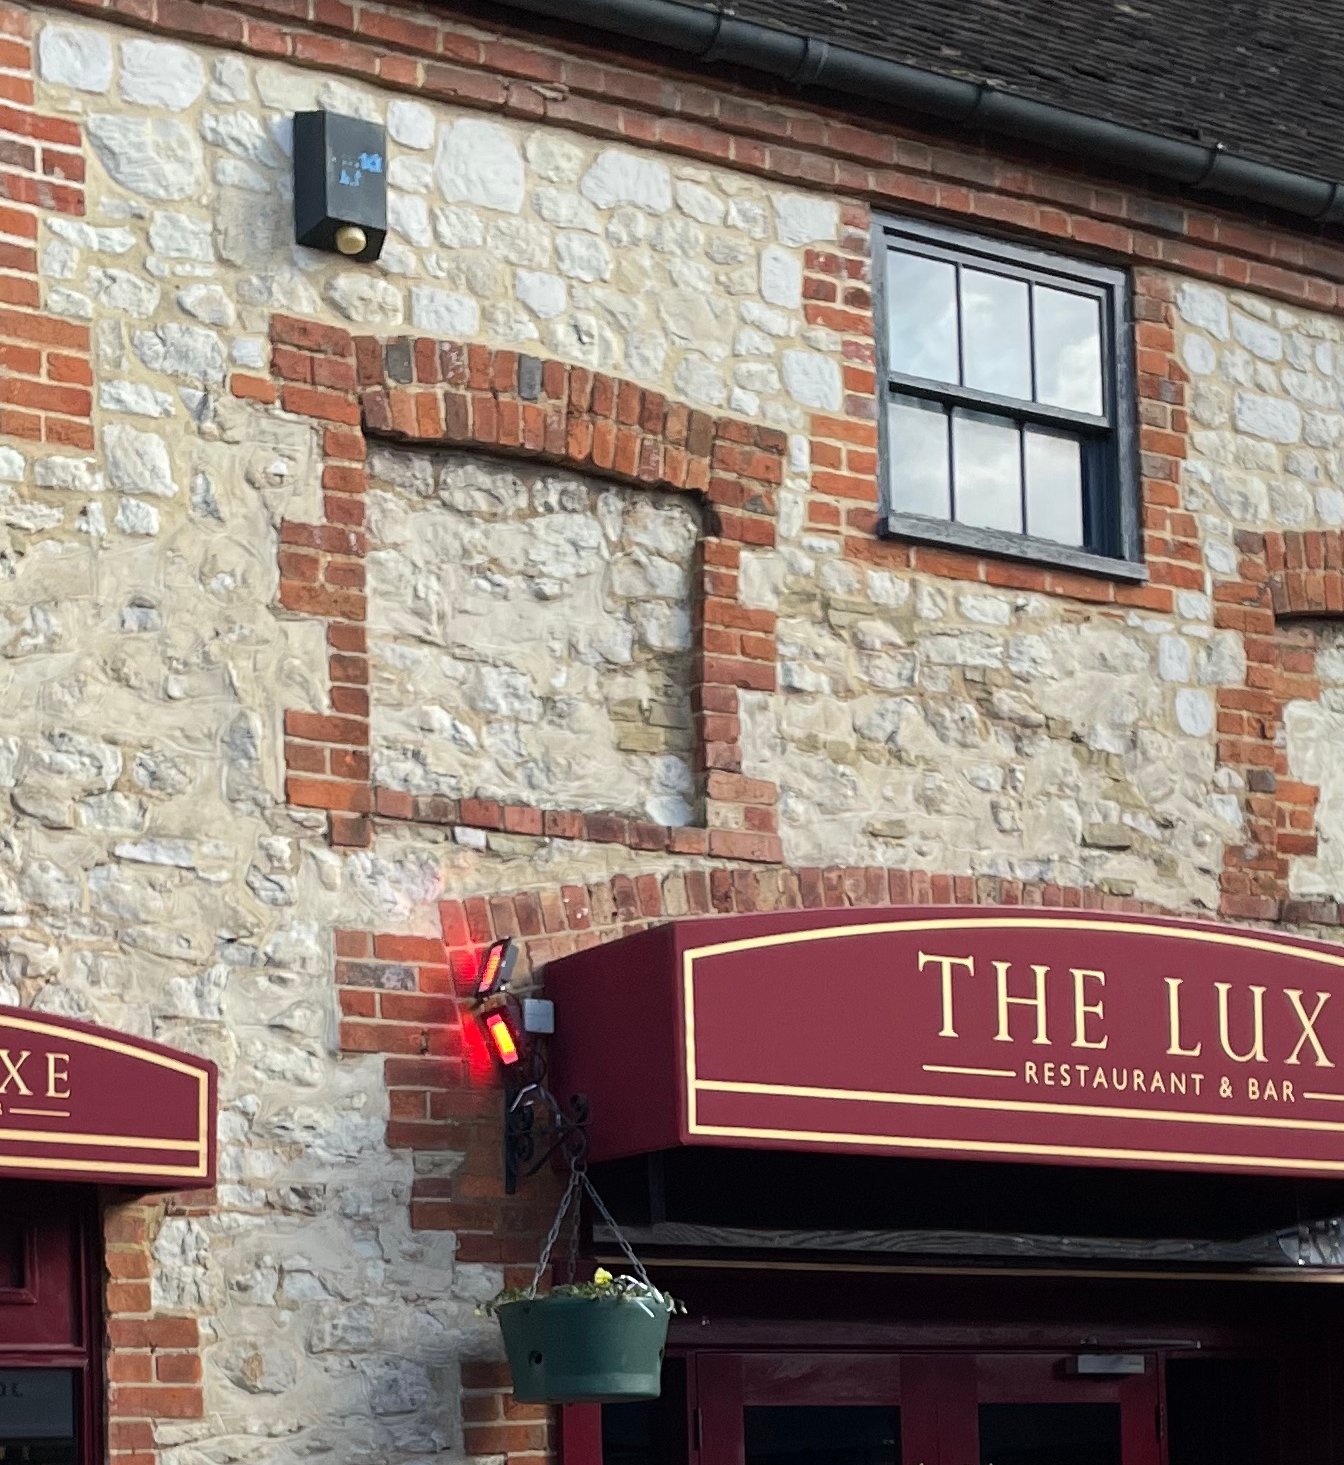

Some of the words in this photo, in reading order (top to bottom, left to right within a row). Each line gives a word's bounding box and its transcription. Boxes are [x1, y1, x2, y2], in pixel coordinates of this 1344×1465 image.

[919, 951, 1108, 1050] THE
[1025, 1061, 1205, 1097] RESTAURANT
[1219, 1076, 1234, 1098] &
[1249, 1077, 1296, 1103] BAR
